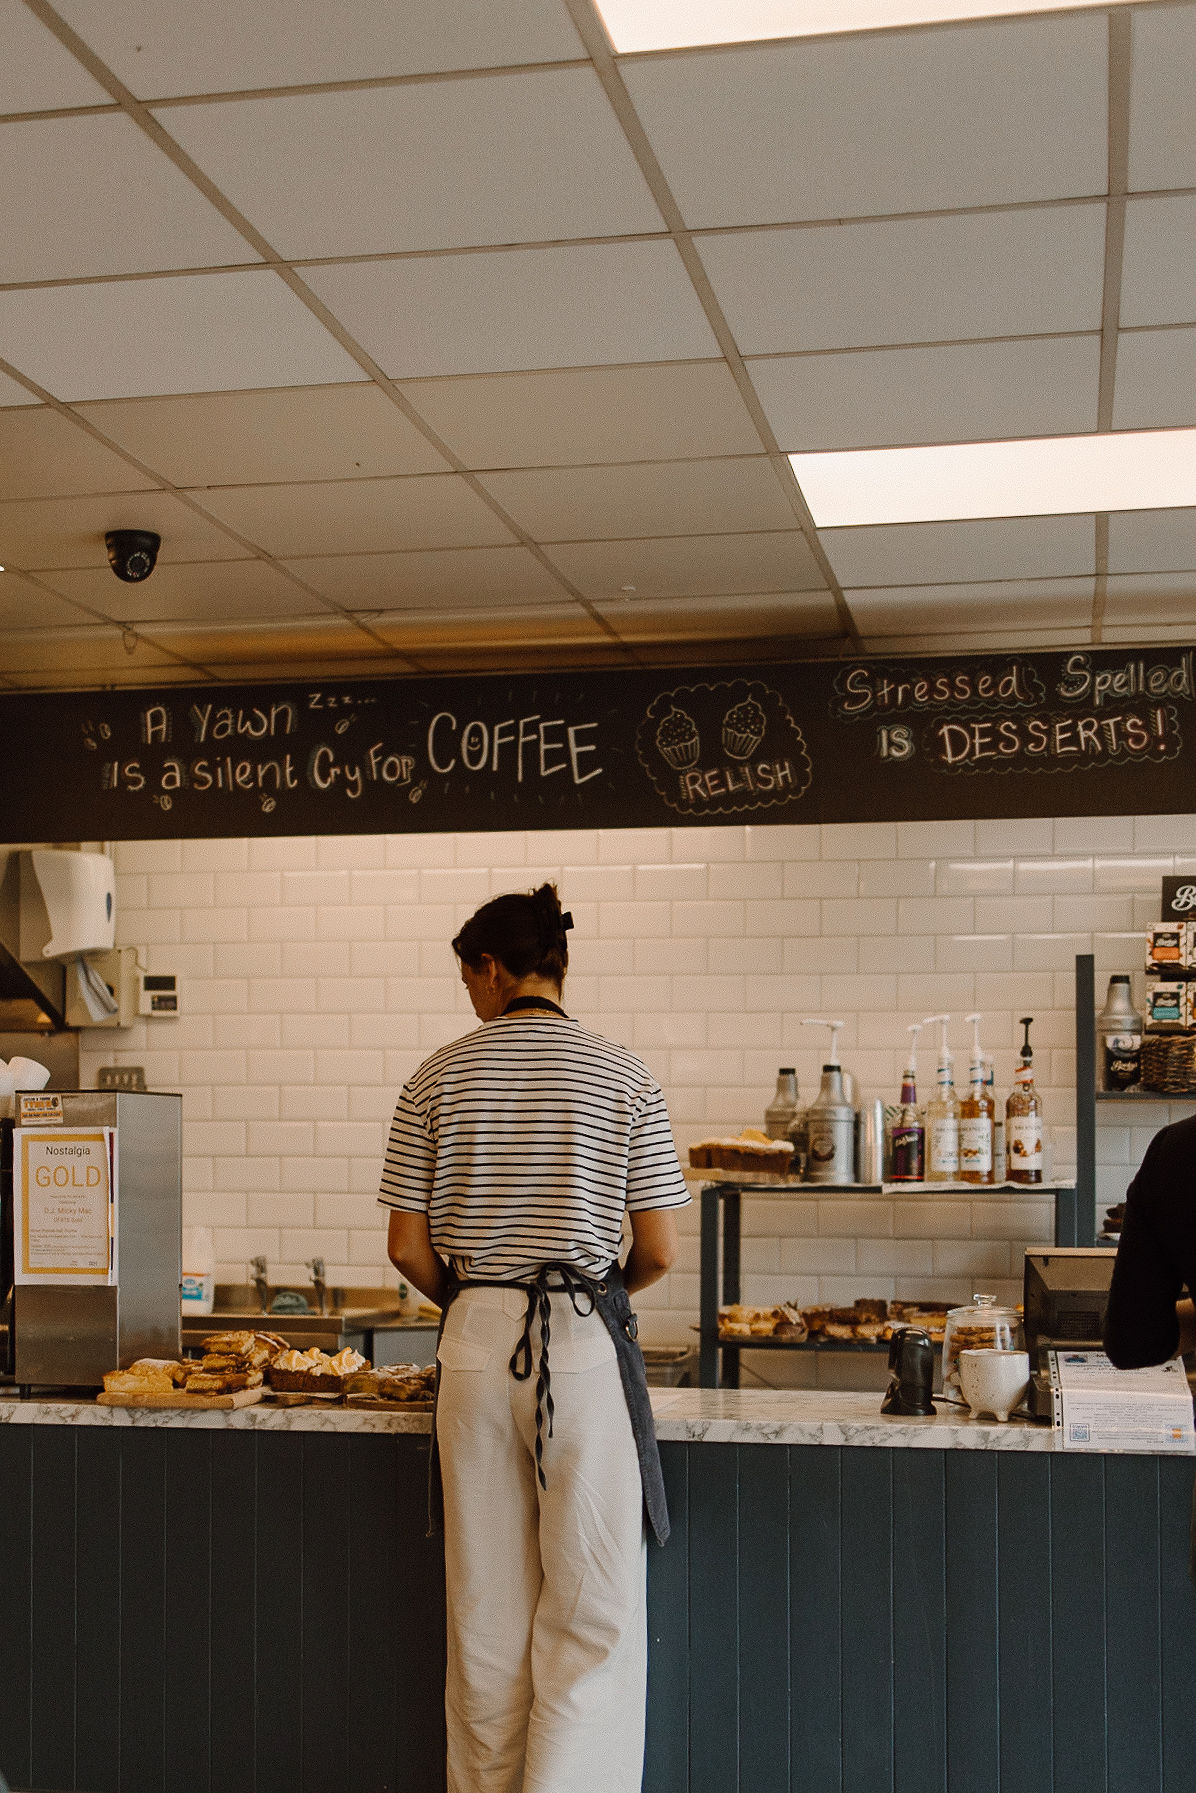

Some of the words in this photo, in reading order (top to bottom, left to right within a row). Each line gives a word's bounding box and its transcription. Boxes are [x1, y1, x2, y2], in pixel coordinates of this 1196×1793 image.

[843, 665, 1024, 710] Stressed
[1060, 654, 1190, 706] Spelled
[146, 705, 169, 744] A
[192, 703, 294, 743] Yawn
[938, 708, 1167, 763] DESSERTS!
[427, 711, 604, 784] COFFEE
[161, 761, 182, 790] a
[192, 753, 298, 791] silent
[684, 760, 793, 800] RELISH
[45, 1146, 91, 1157] Nostalgia
[35, 1165, 101, 1188] GOLD
